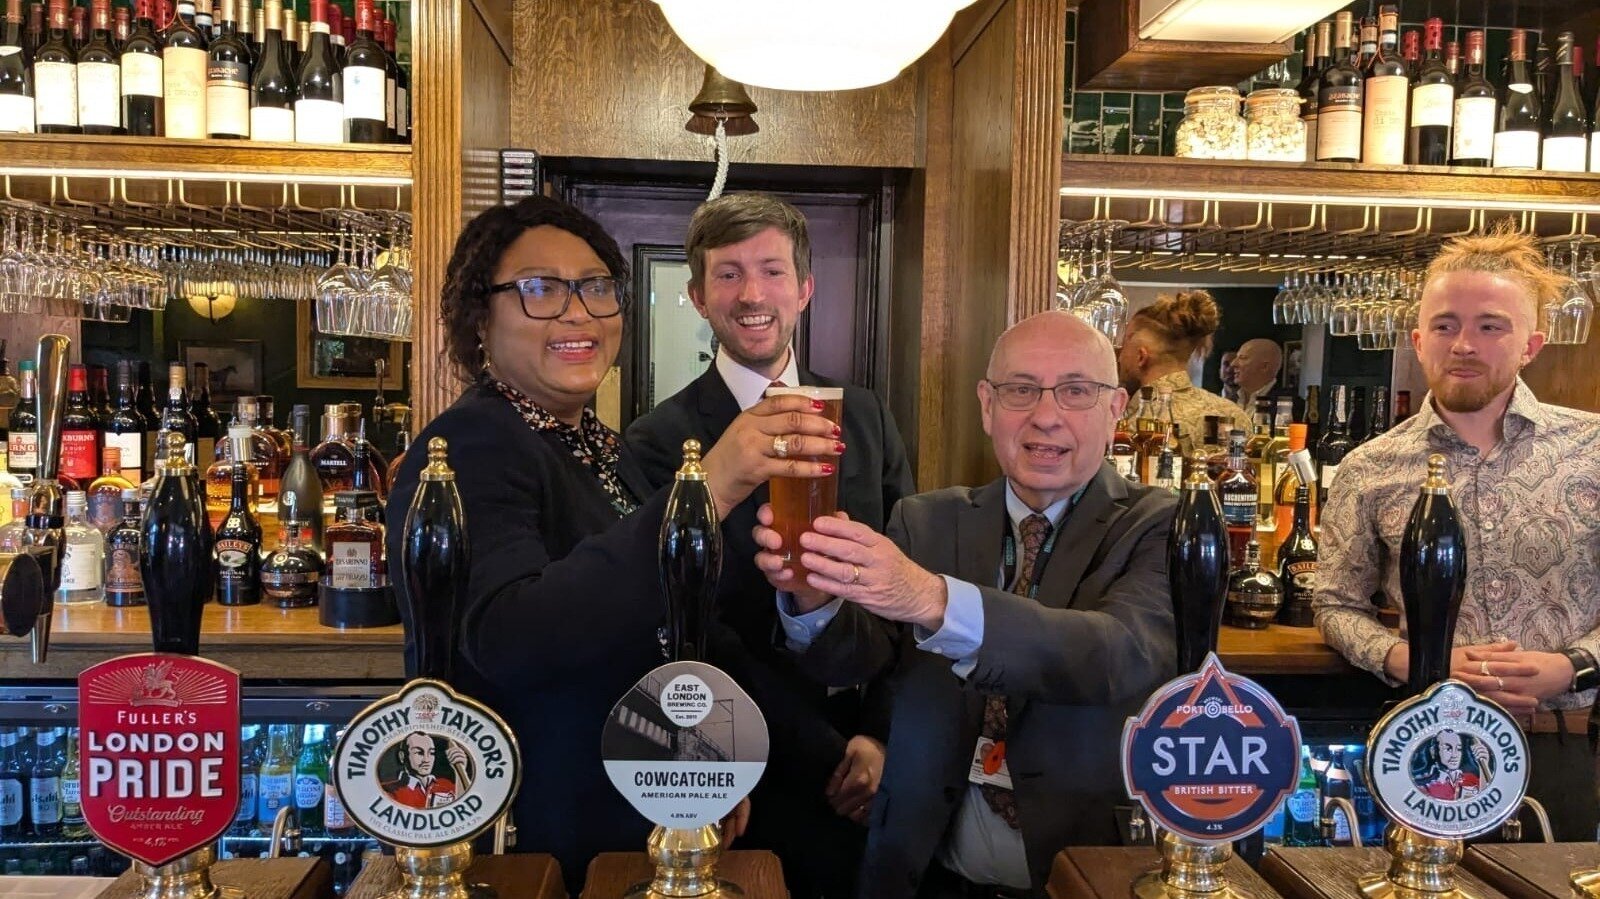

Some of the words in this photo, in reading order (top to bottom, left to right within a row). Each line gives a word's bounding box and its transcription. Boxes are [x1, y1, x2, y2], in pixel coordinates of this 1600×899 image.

[117, 710, 197, 725] FULLER'S
[88, 731, 224, 753] LONDON
[347, 706, 412, 780] TIMOTHY
[440, 706, 505, 780] TAYLOR'S
[1382, 705, 1440, 775] TIMOTHY
[1465, 705, 1519, 774] TAYLOR'S
[1152, 735, 1270, 777] STAR
[89, 757, 223, 798] PRIDE
[634, 771, 735, 787] COWCATCHER
[1174, 786, 1214, 795] BRITISH
[1218, 785, 1254, 794] BITTER
[107, 804, 205, 826] Outstanding
[368, 794, 483, 831] LANDLORD
[1403, 787, 1502, 822] LANDLORD
[383, 825, 413, 839] CLASSIC
[414, 831, 431, 839] PALE
[434, 831, 448, 839] ALE
